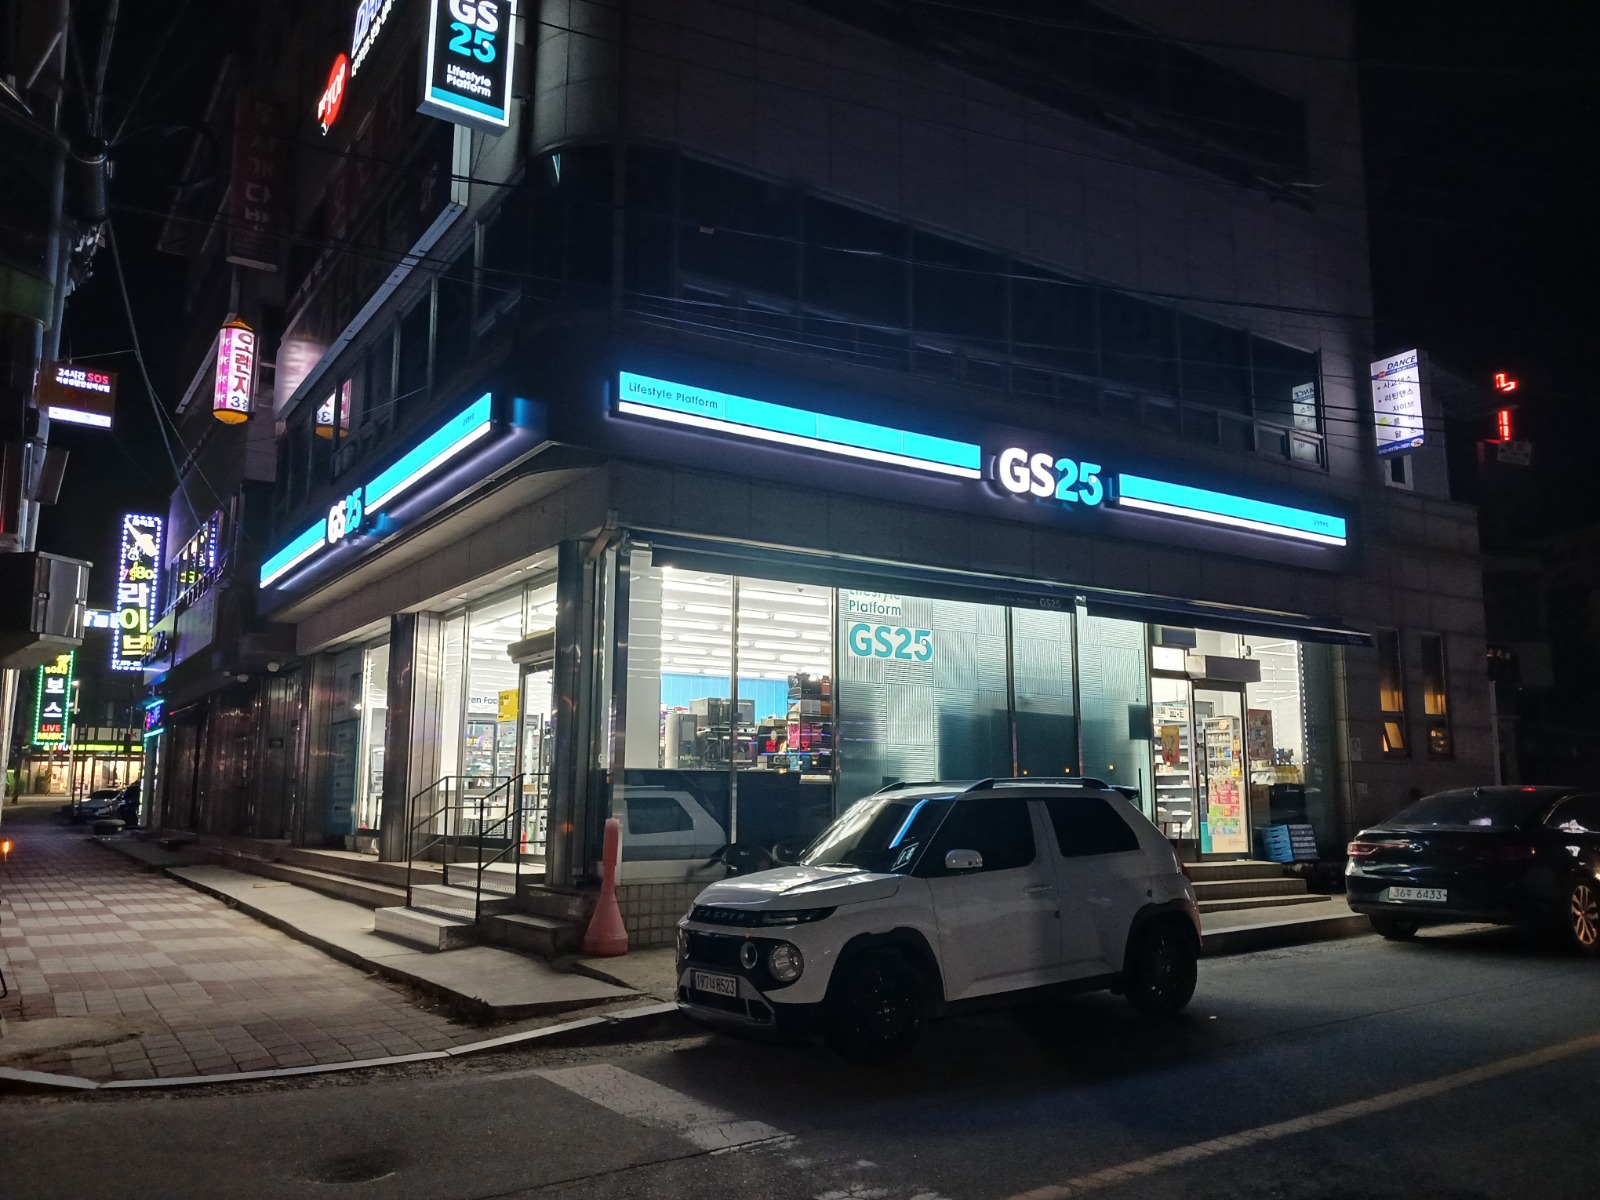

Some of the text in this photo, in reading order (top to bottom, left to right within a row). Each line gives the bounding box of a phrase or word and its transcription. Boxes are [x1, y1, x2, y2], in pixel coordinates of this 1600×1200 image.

[449, 0, 499, 32] GS
[449, 21, 496, 63] 25
[446, 74, 492, 97] Platform
[447, 63, 492, 87] Lifestyle
[1387, 355, 1416, 370] DANCE
[58, 368, 86, 380] 24시간
[87, 372, 109, 385] SOS
[629, 382, 718, 409] Lifestyle Platform
[999, 447, 1103, 506] GS25
[328, 487, 362, 544] GS25
[849, 599, 901, 616] Platform
[1039, 598, 1062, 609] GS25
[119, 583, 156, 656] 라이브
[849, 623, 933, 662] GS25
[43, 677, 65, 718] 보스
[483, 696, 499, 705] Foo
[37, 732, 64, 740] MUSIC
[42, 724, 61, 732] LIVE
[1416, 889, 1442, 900] 6433
[696, 909, 745, 921] CASPER
